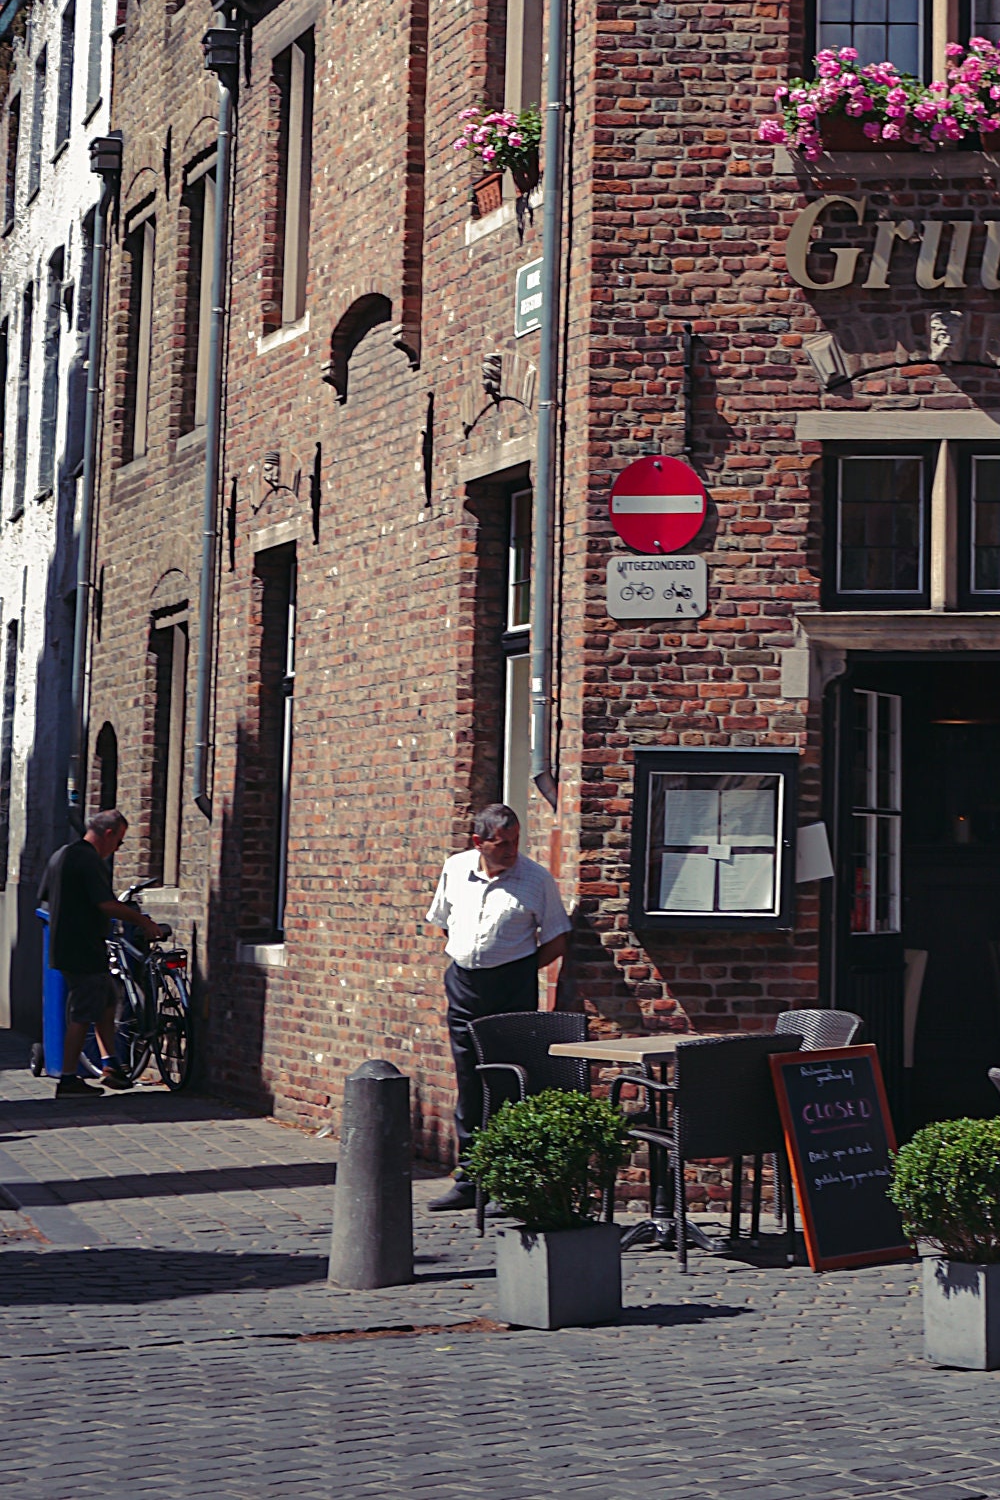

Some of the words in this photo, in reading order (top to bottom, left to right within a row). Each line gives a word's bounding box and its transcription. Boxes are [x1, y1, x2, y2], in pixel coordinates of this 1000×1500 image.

[617, 560, 697, 572] UITGEZONDERD
[675, 603, 684, 613] A
[802, 1098, 873, 1124] CLOSED
